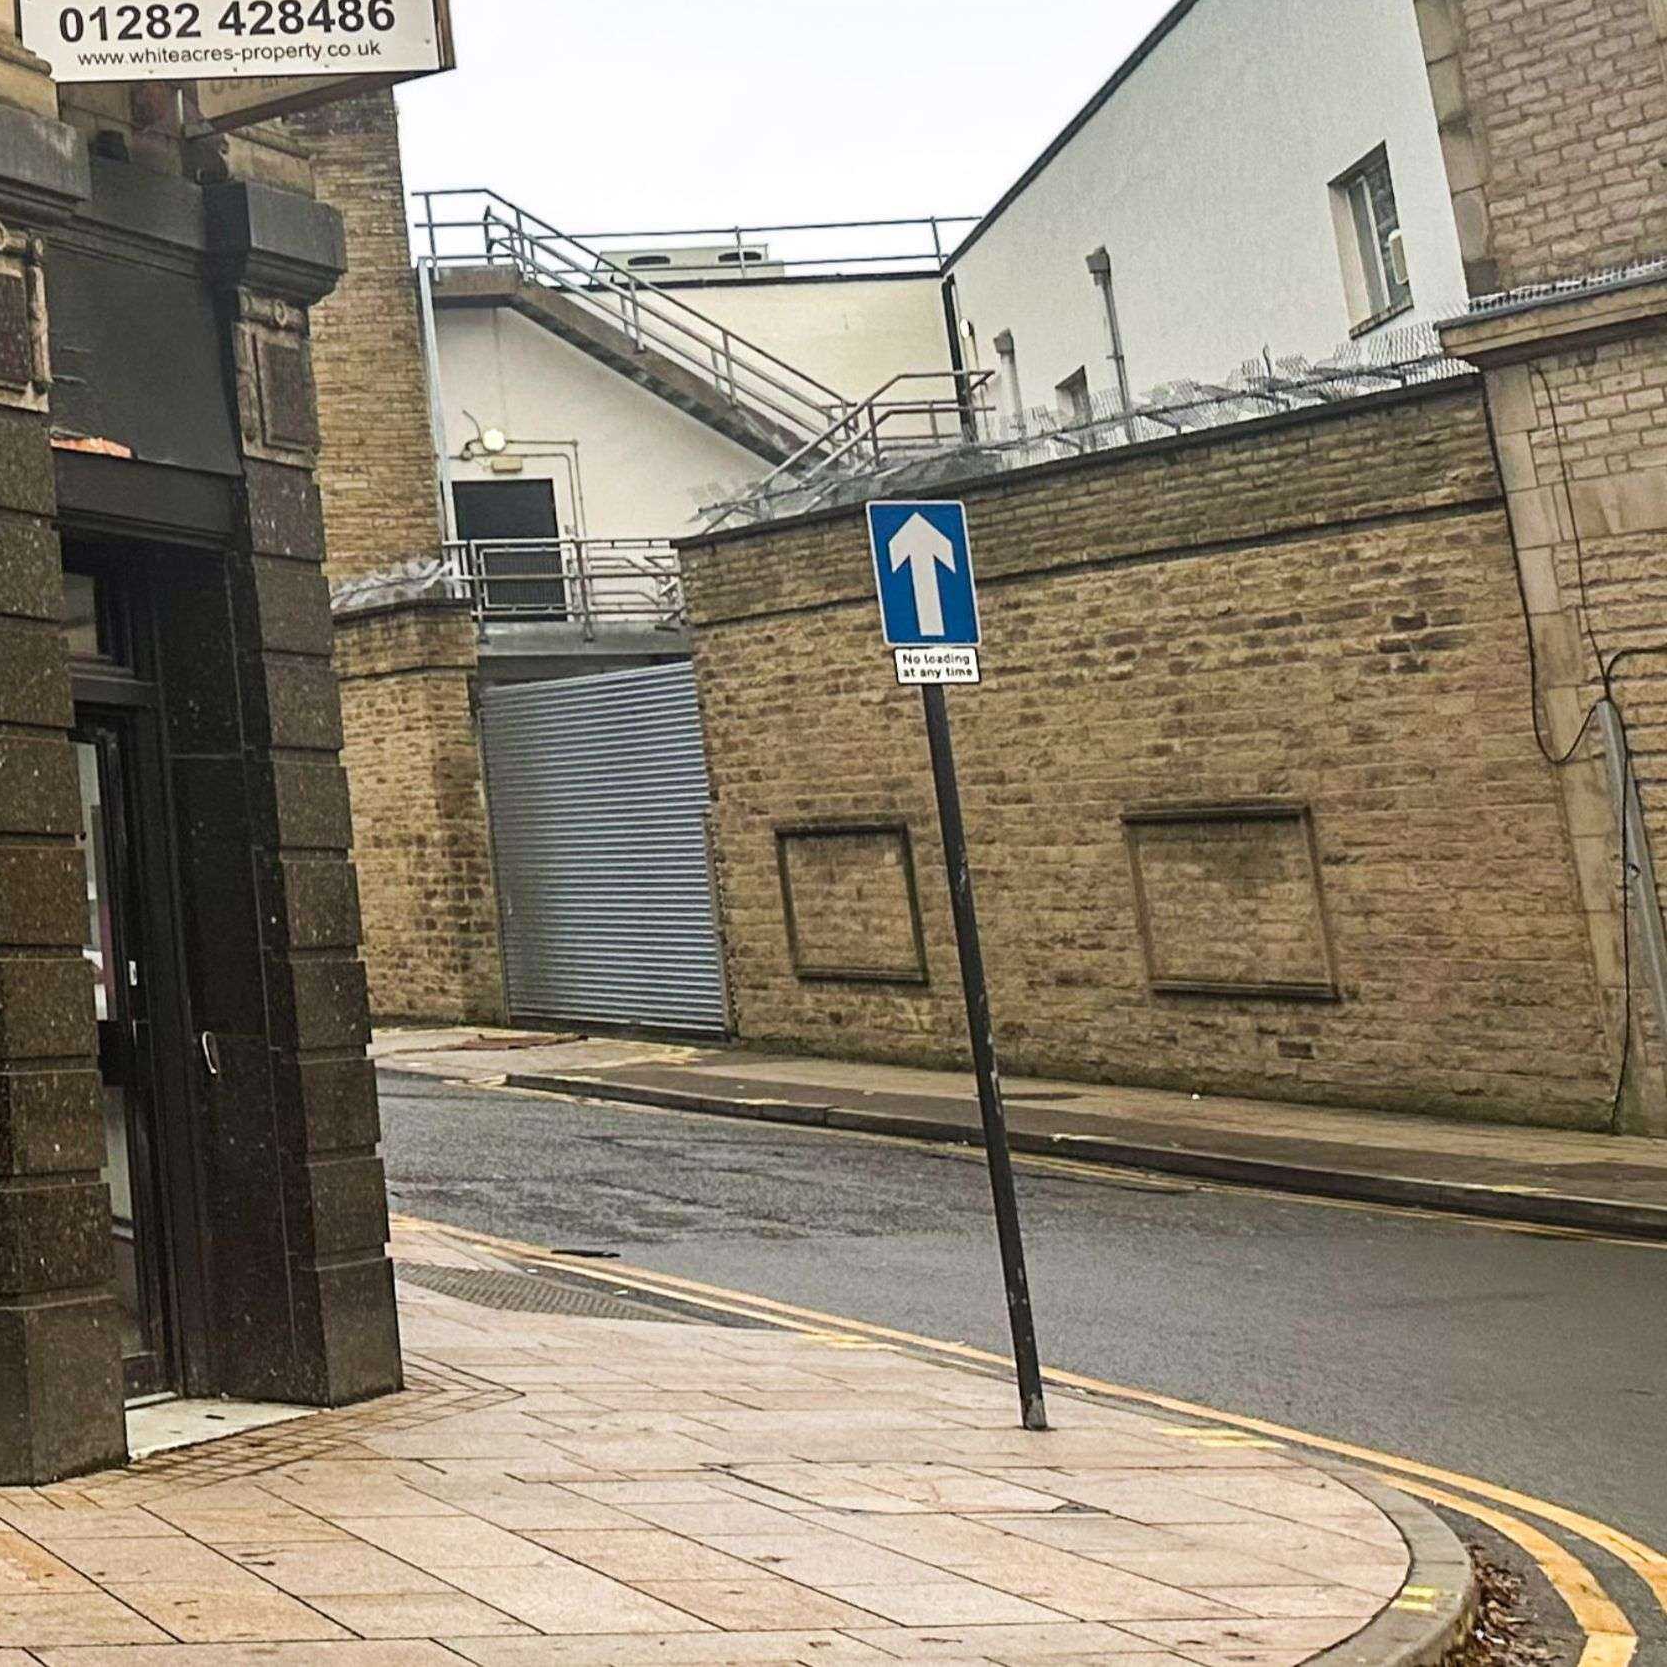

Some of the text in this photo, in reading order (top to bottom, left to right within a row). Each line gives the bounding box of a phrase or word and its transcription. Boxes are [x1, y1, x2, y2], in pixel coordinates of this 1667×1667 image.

[59, 2, 201, 44] 01282
[902, 653, 970, 665] No loading
[903, 667, 973, 679] at any time
